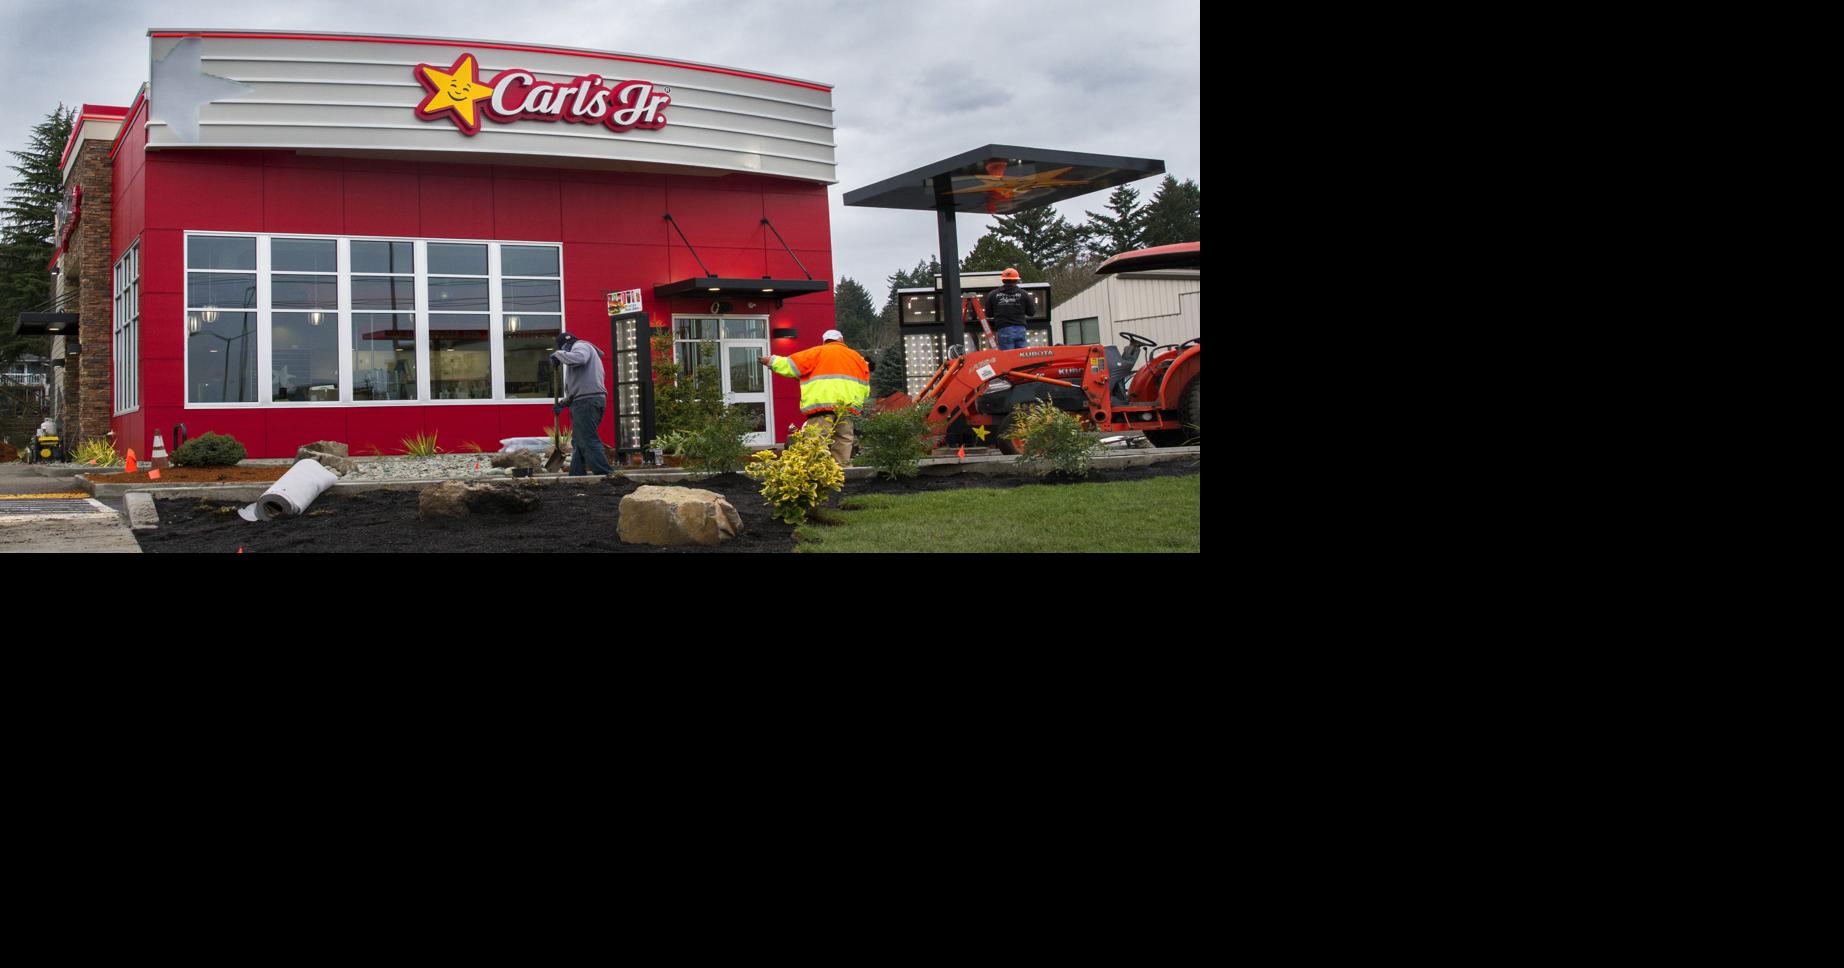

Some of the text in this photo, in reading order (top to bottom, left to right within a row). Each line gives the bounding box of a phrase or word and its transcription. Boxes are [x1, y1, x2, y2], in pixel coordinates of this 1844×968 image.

[491, 72, 670, 126] Carl's Jr.
[1019, 350, 1054, 358] KUBOTA
